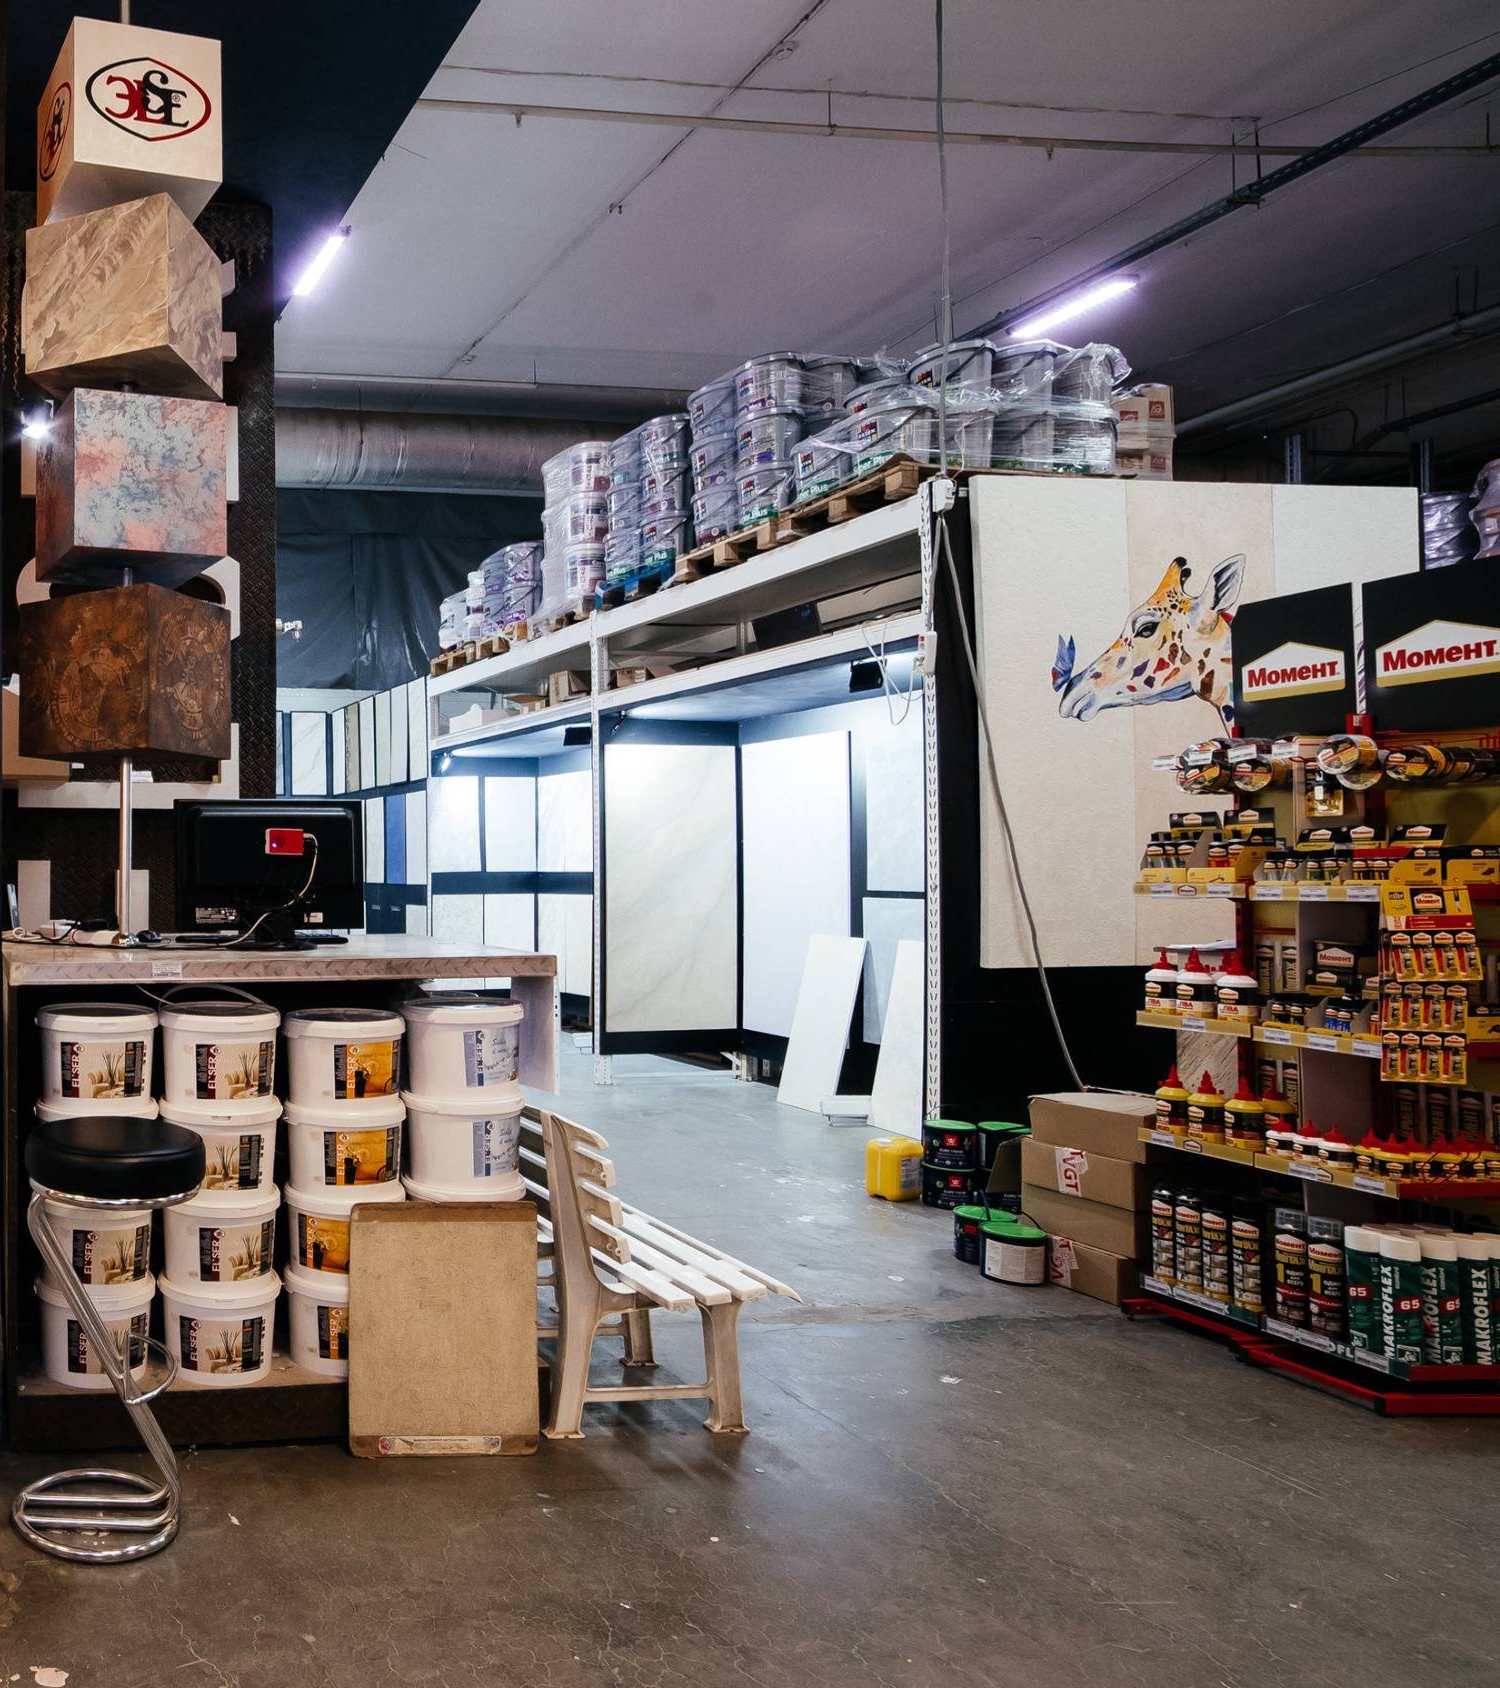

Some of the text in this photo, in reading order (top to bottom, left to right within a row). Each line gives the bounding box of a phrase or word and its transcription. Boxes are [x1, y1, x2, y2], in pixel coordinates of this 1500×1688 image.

[1383, 639, 1497, 672] Момент
[1247, 661, 1339, 688] Момент
[1319, 953, 1352, 963] Момент
[1349, 1287, 1367, 1297] 65
[1401, 1299, 1420, 1311] 65
[1381, 1264, 1395, 1360] MAKROFLEX
[1471, 1268, 1492, 1366] MAKROFLEX
